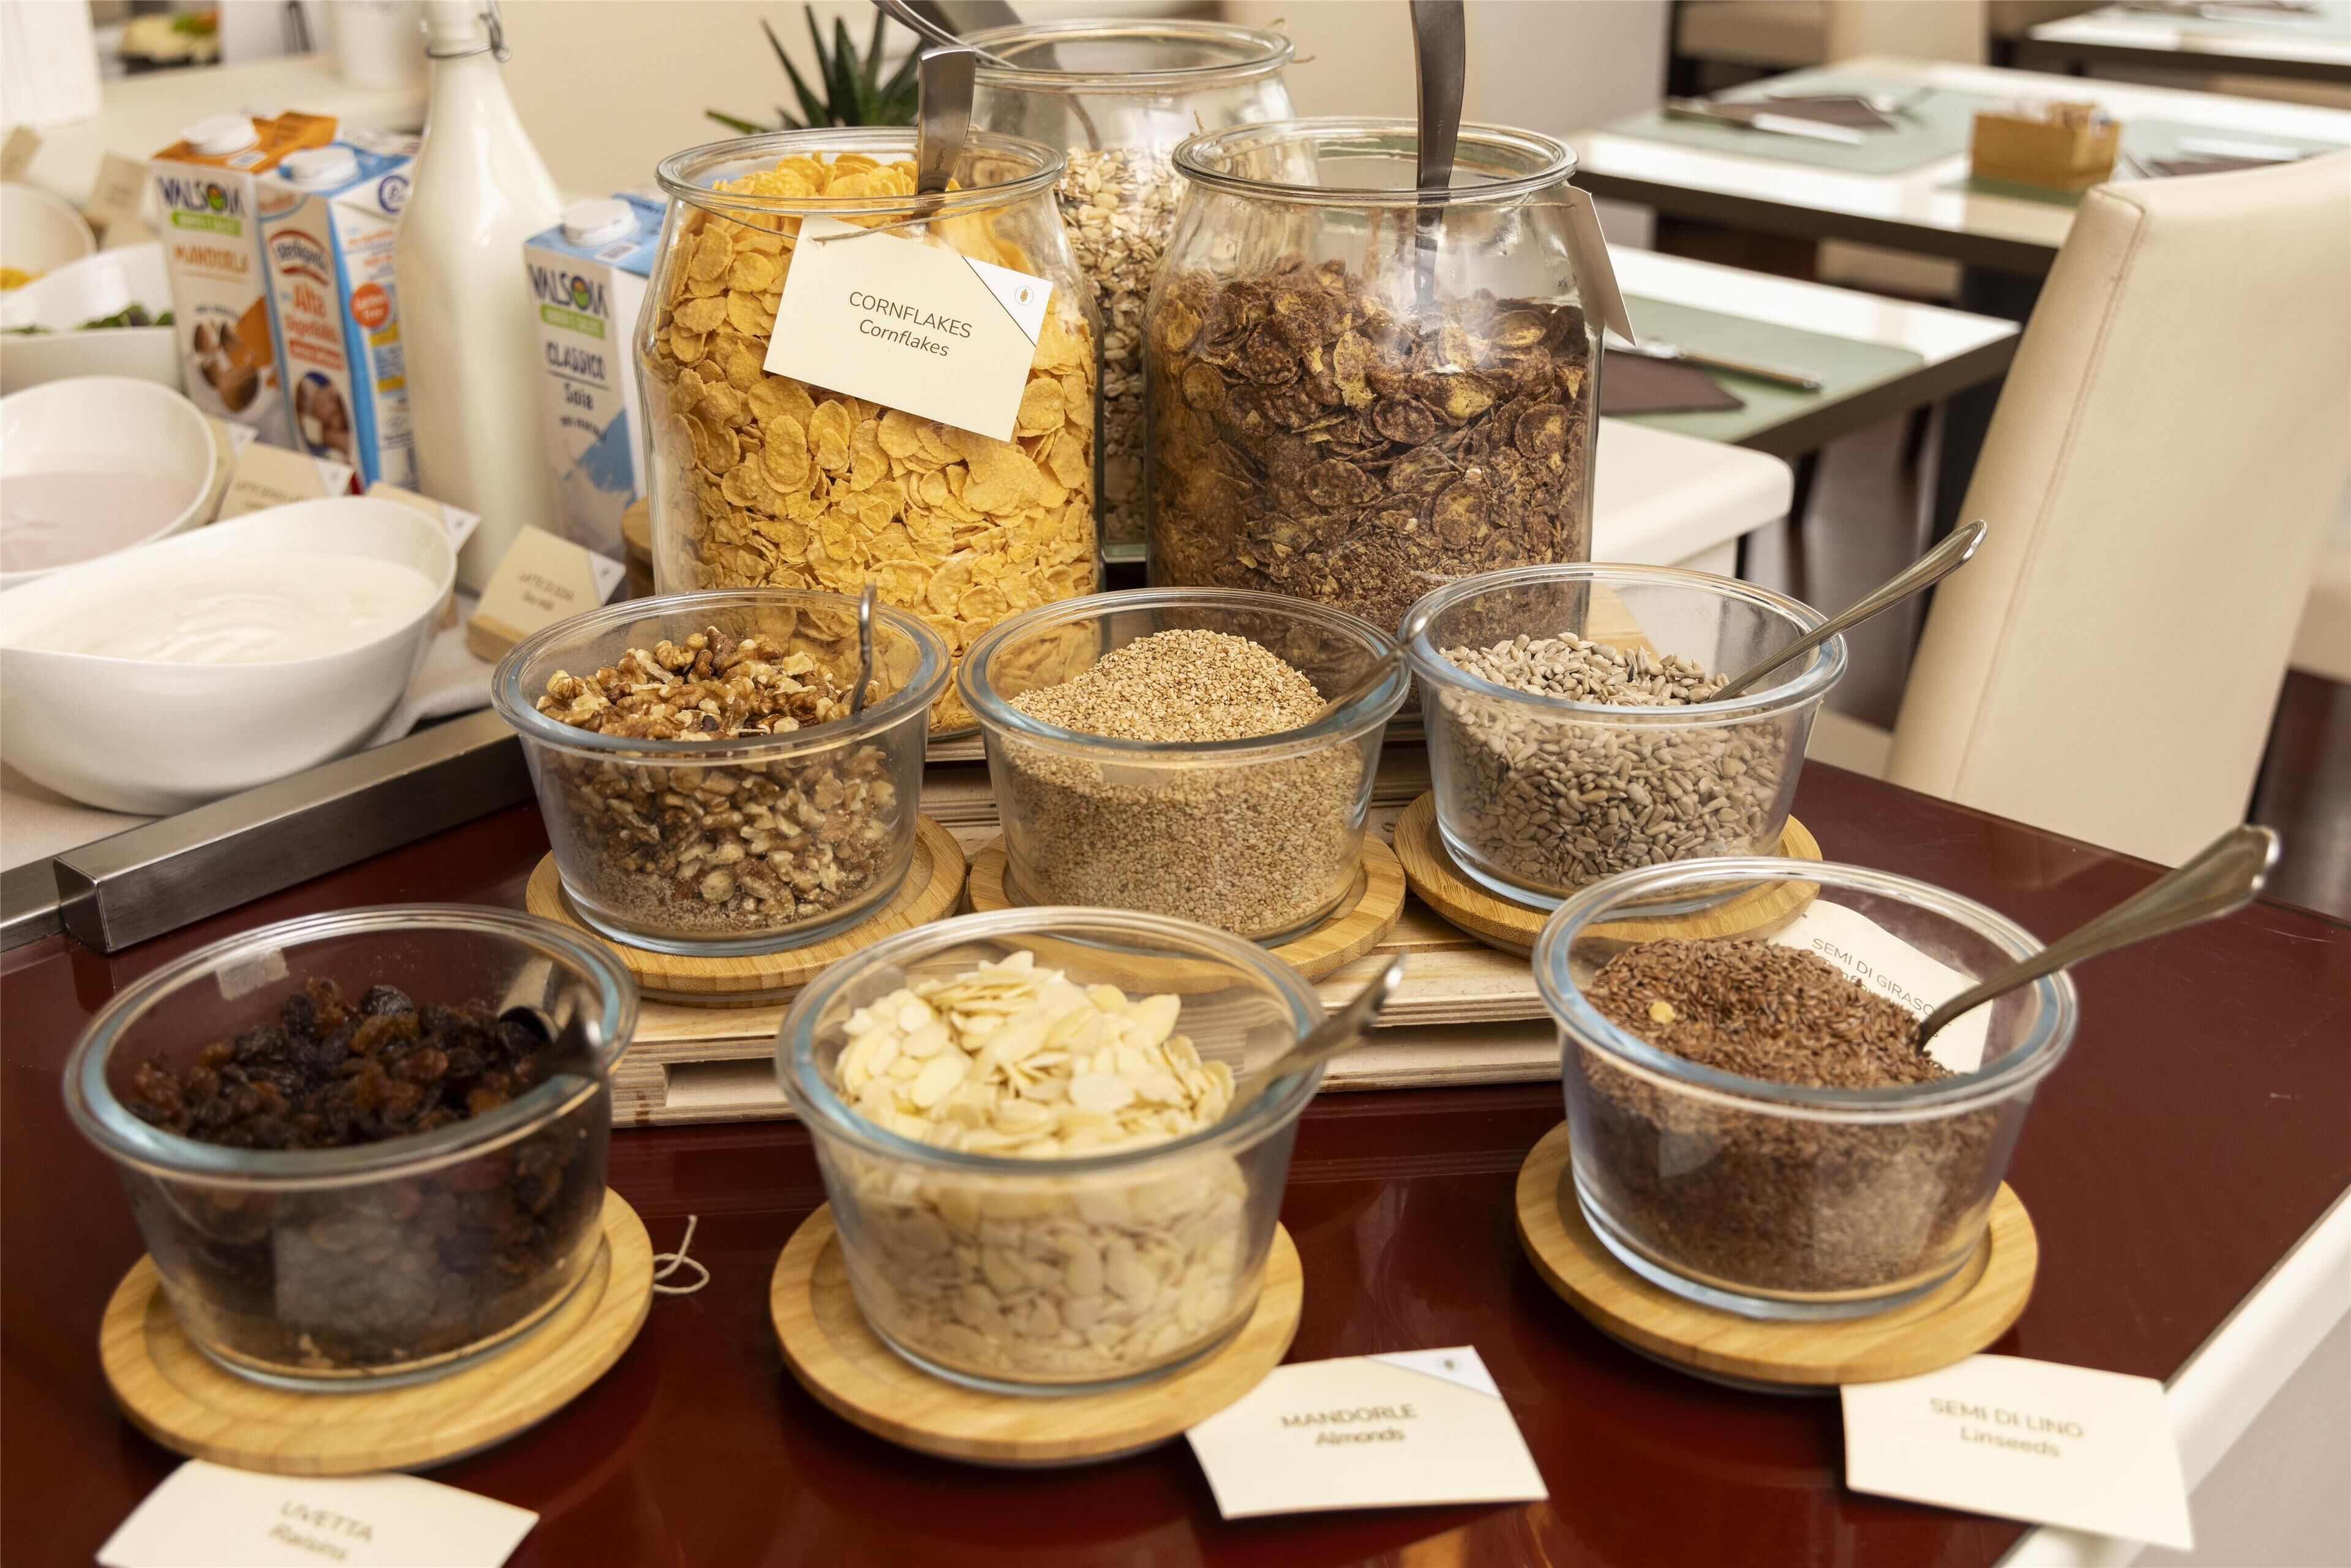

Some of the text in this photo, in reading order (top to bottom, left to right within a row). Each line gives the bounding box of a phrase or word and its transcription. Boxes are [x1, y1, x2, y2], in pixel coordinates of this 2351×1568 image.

[849, 291, 973, 339] CORNFLAKES
[859, 318, 950, 356] Cornflakes
[546, 341, 606, 381] CLASSICO
[1812, 937, 1853, 966] SEMI
[1857, 959, 1873, 979] DI
[1876, 973, 1951, 1026] GIRASO
[1281, 1403, 1418, 1429] MANDORLE
[1930, 1397, 2083, 1438] SEMI DI LINO
[1316, 1427, 1404, 1447] Almonds
[1960, 1426, 2060, 1458] Linseeds
[280, 1499, 373, 1542] UVETTA
